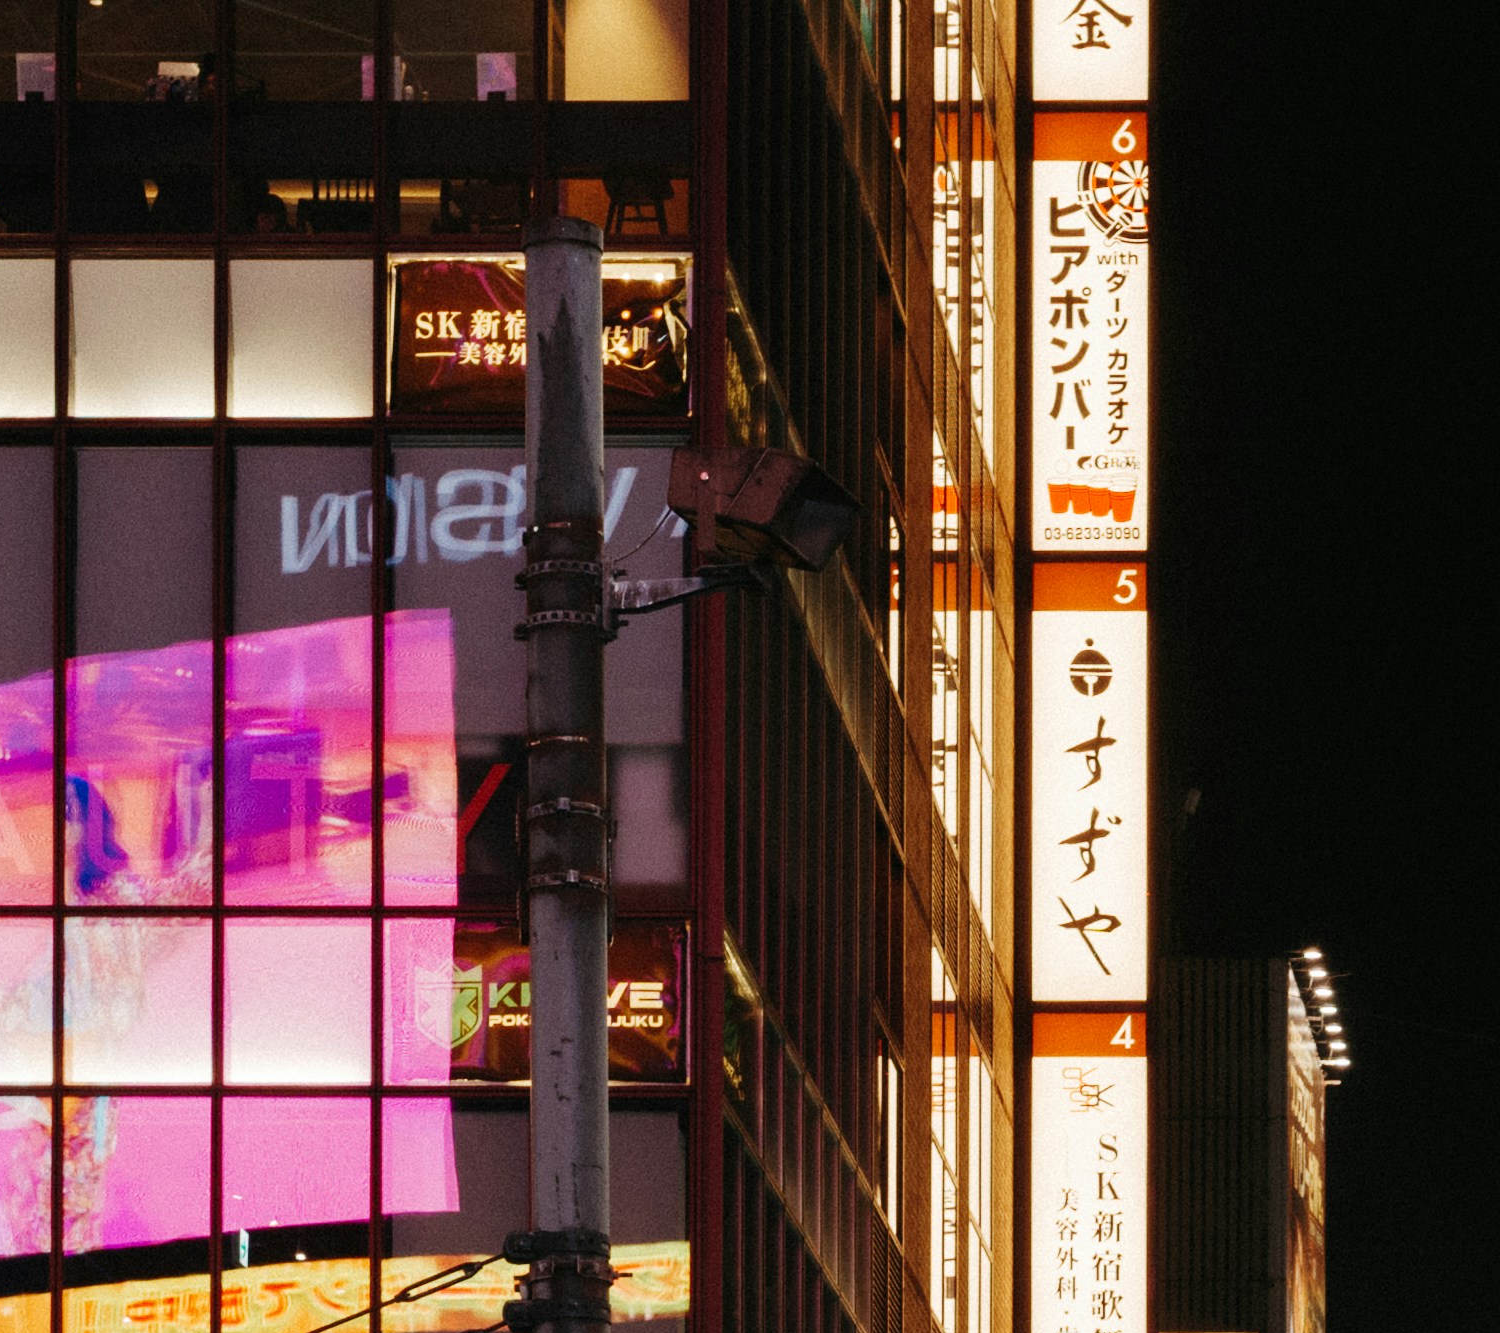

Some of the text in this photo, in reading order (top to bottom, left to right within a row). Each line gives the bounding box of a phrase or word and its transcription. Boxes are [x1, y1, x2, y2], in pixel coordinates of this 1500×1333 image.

[1111, 119, 1137, 154] 6
[1096, 252, 1139, 266] with
[415, 312, 462, 340] SK
[1106, 270, 1130, 445] ダーツ カラオケ
[1113, 570, 1138, 604] 5
[1057, 715, 1122, 976] すずや
[1110, 1015, 1135, 1050] 4
